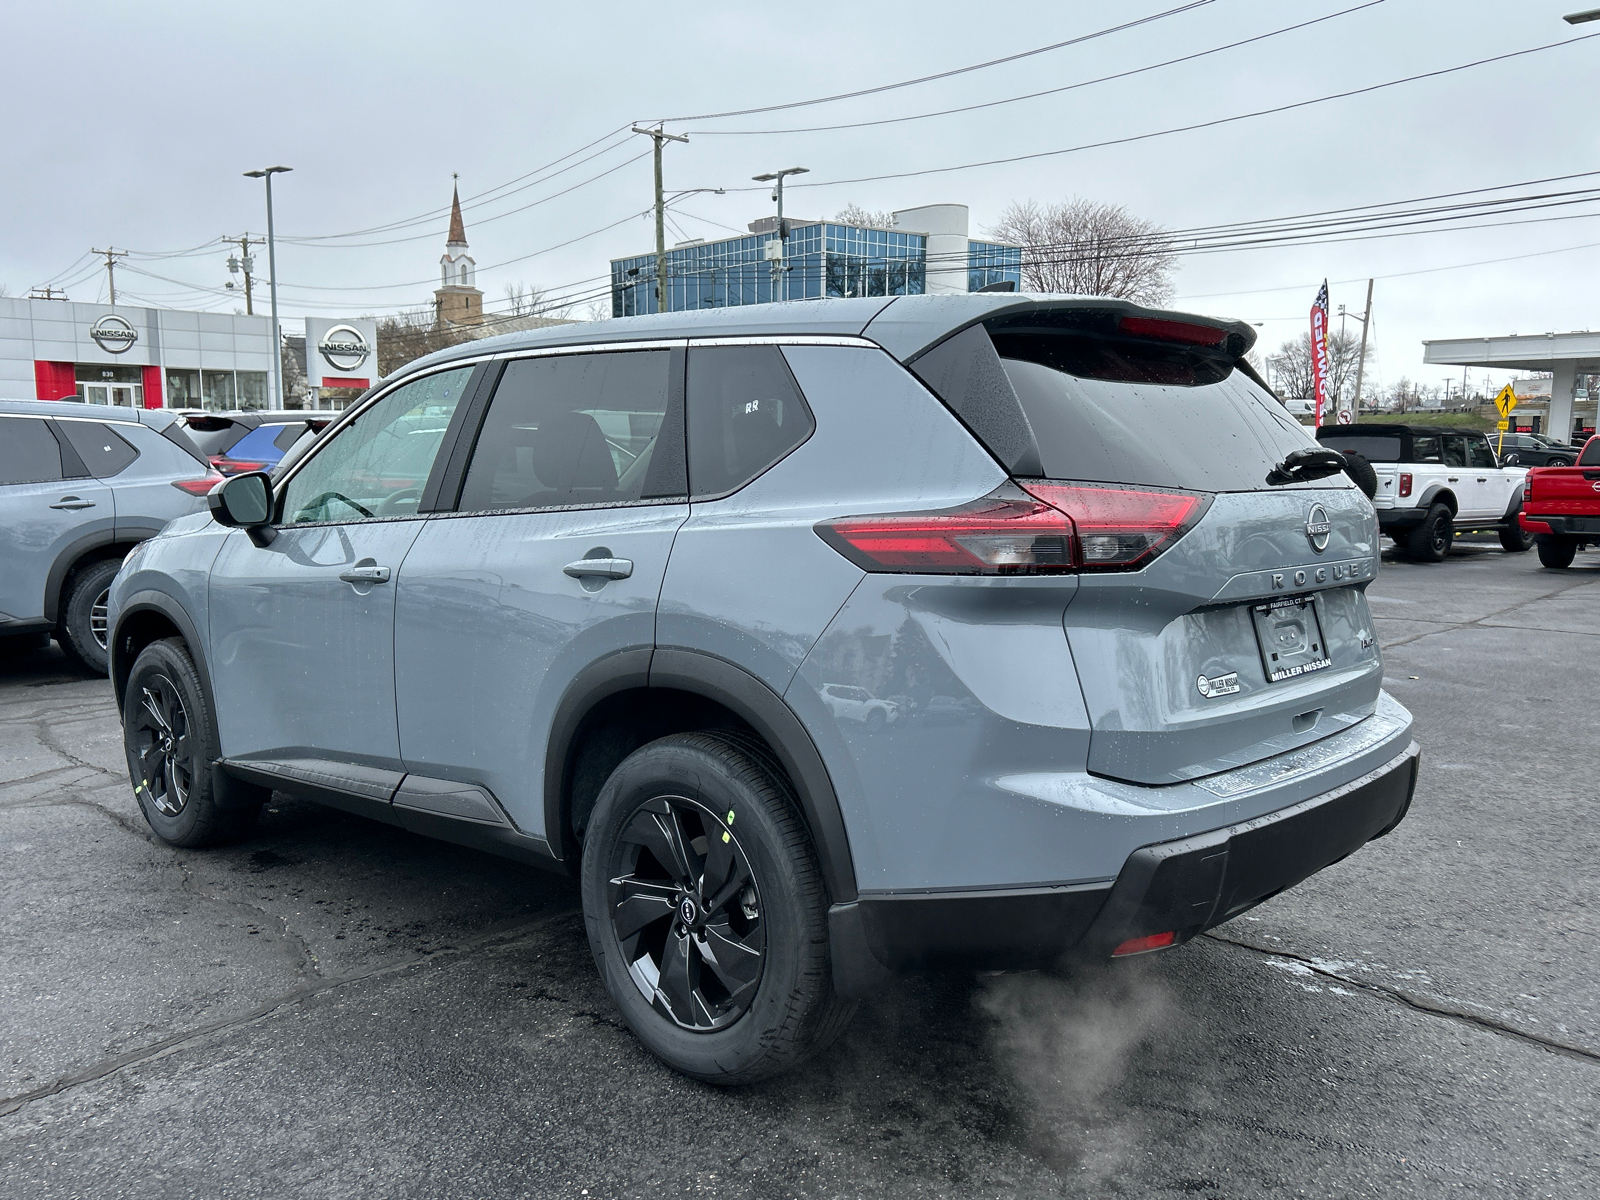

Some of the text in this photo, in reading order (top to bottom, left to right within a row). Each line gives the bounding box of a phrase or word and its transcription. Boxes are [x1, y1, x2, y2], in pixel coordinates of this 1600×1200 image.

[96, 329, 134, 338] NISSAN
[324, 343, 367, 352] NISSAN
[1271, 564, 1359, 590] ROGUE
[1271, 658, 1332, 682] MILLER NISSAN
